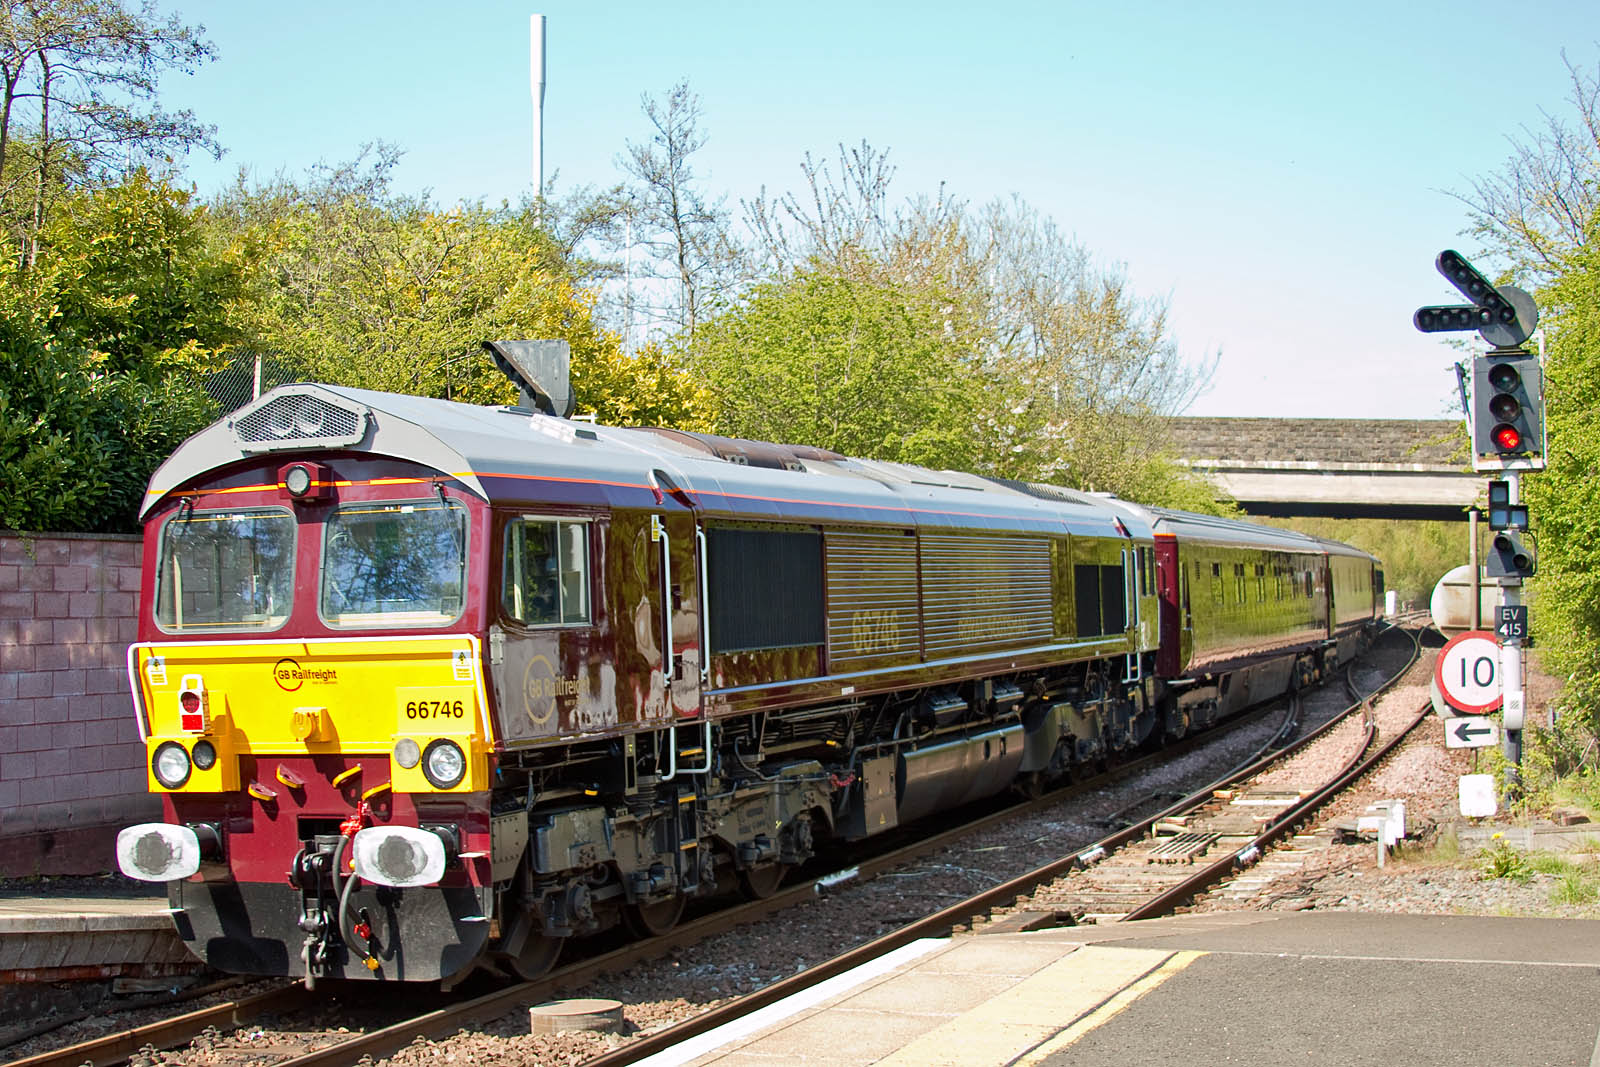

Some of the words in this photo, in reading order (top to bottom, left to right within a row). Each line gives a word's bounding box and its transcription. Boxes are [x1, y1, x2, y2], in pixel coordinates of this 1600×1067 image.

[1502, 608, 1519, 620] EV
[852, 609, 899, 654] 66746
[1499, 623, 1521, 636] 415
[278, 670, 291, 680] GB
[291, 669, 337, 681] Railfreight
[1461, 656, 1494, 687] 10
[528, 678, 542, 698] GB
[406, 700, 463, 719] 66746
